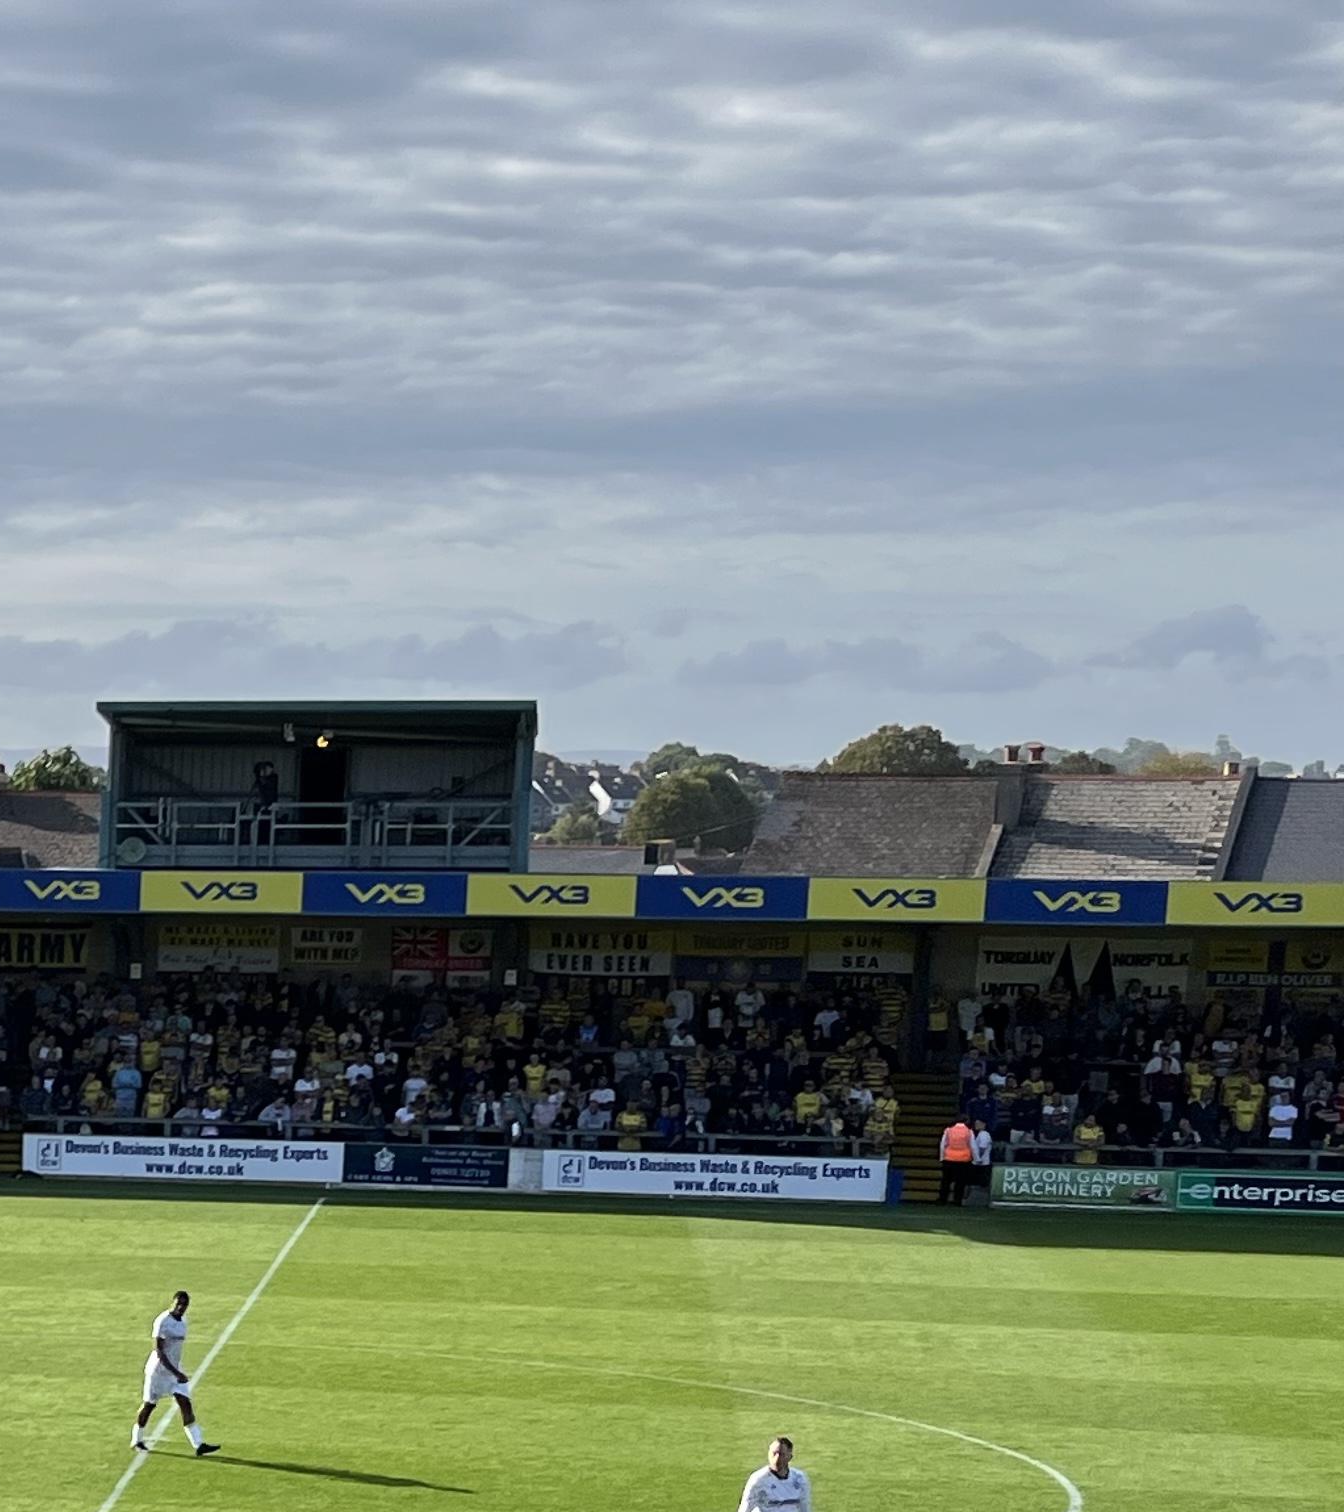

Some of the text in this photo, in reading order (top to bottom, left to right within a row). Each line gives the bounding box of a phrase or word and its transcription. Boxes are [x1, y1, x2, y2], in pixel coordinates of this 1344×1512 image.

[25, 878, 101, 901] VX3
[181, 879, 259, 902] VX3
[345, 881, 426, 905] VX3
[511, 882, 590, 905] VX3
[682, 885, 765, 908] VX3
[853, 887, 937, 910] VX3
[1034, 889, 1121, 913] VX3
[1215, 891, 1304, 913] VX3
[551, 932, 649, 950] HAVE YOU
[841, 934, 884, 949] SUN
[546, 953, 650, 972] EVER SEEN
[842, 955, 880, 969] SEA
[983, 950, 1055, 965] TORQUAY
[1113, 952, 1189, 967] NORFOLK
[65, 1141, 329, 1163] Devon's Business Waste & Recycling Experts
[145, 1162, 245, 1176] www.dcw.co.uk
[587, 1156, 871, 1180] Devon's Business Waste & Recycling Experts
[1003, 1168, 1159, 1186] DEVON GARDEN
[673, 1178, 779, 1194] www.dcw.co.uk
[1002, 1180, 1117, 1198] MACHINERY
[1189, 1183, 1344, 1206] enterprise
